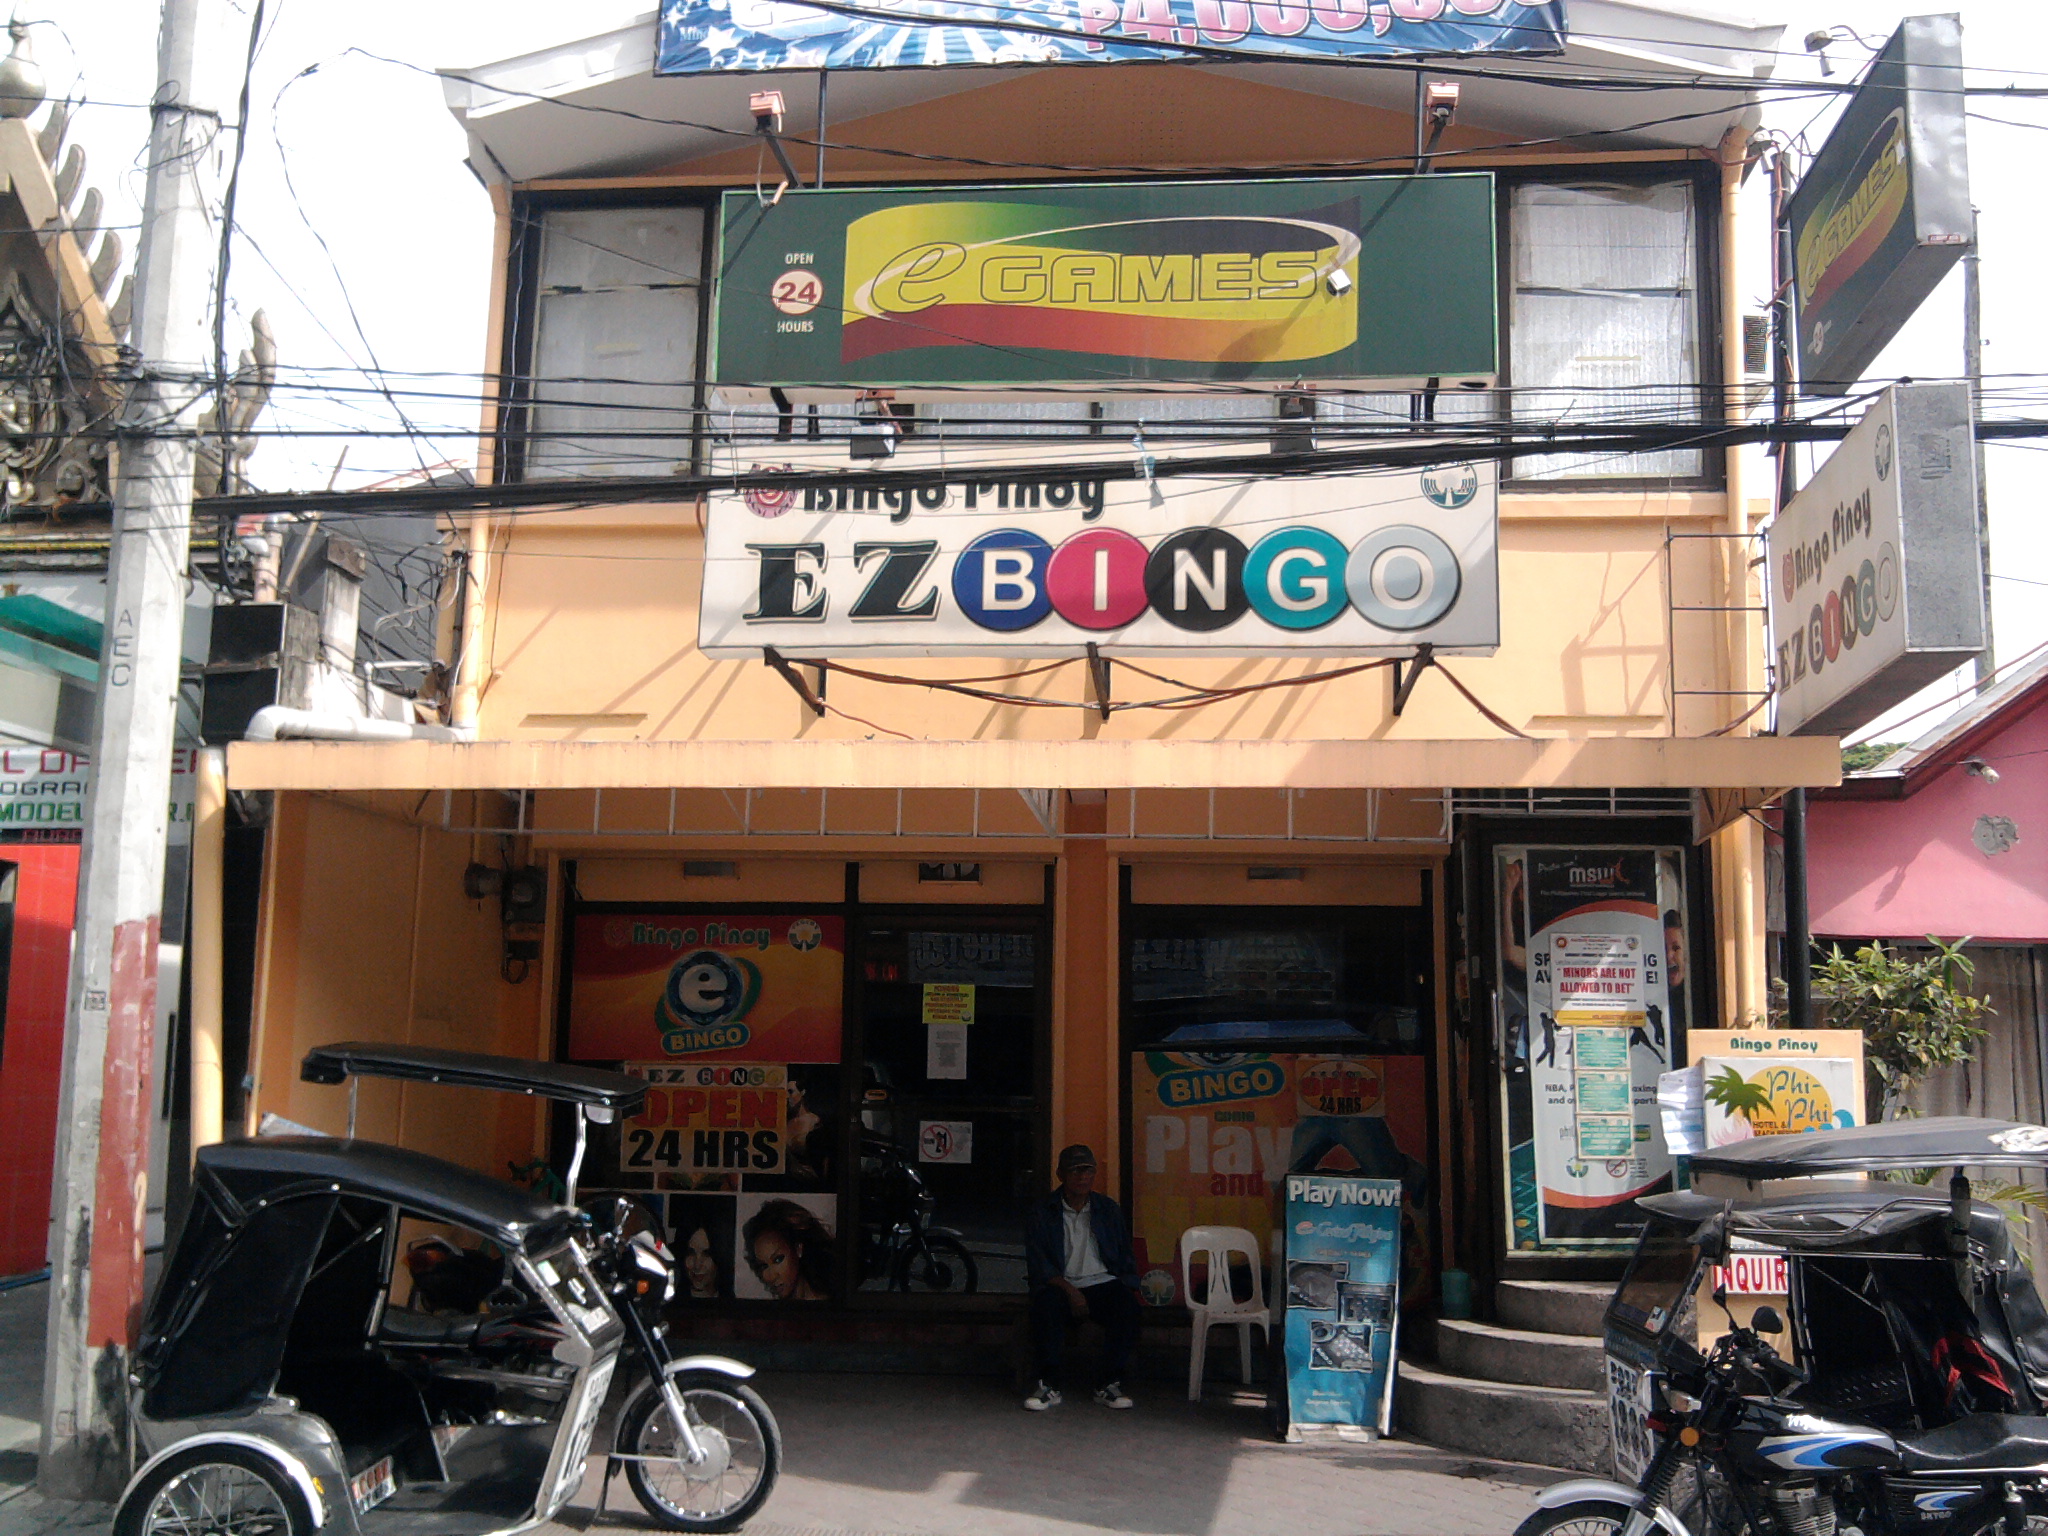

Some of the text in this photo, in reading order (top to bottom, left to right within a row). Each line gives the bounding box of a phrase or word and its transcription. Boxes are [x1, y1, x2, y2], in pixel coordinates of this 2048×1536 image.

[785, 253, 814, 265] OPEN
[779, 281, 818, 304] 24
[776, 320, 815, 333] HOURS
[803, 479, 1105, 524] Bingo Pinoy
[1796, 486, 1872, 591] Bingo Pinoy
[742, 539, 1440, 623] EZ BINGO
[1811, 552, 1893, 663] BINGO
[632, 921, 699, 950] Bingo
[704, 922, 771, 951] Pinoy
[678, 963, 729, 1014] e
[1560, 981, 1600, 994] ALLOWED
[1601, 982, 1613, 994] TO
[1600, 967, 1617, 979] ARE
[1618, 968, 1637, 980] NOT
[669, 1026, 743, 1052] BINGO
[1730, 1037, 1819, 1054] Bingo Pinoy
[647, 1067, 784, 1084] EZ BINGO
[1169, 1067, 1274, 1103] BINGO
[630, 1089, 778, 1129] OPEN
[1785, 1097, 1830, 1129] Phi
[1752, 1120, 1779, 1129] HOTEL
[627, 1129, 779, 1170] 24 HRS
[1145, 1114, 1295, 1182] Play
[1209, 1171, 1265, 1197] and
[1288, 1179, 1402, 1209] Play Now!
